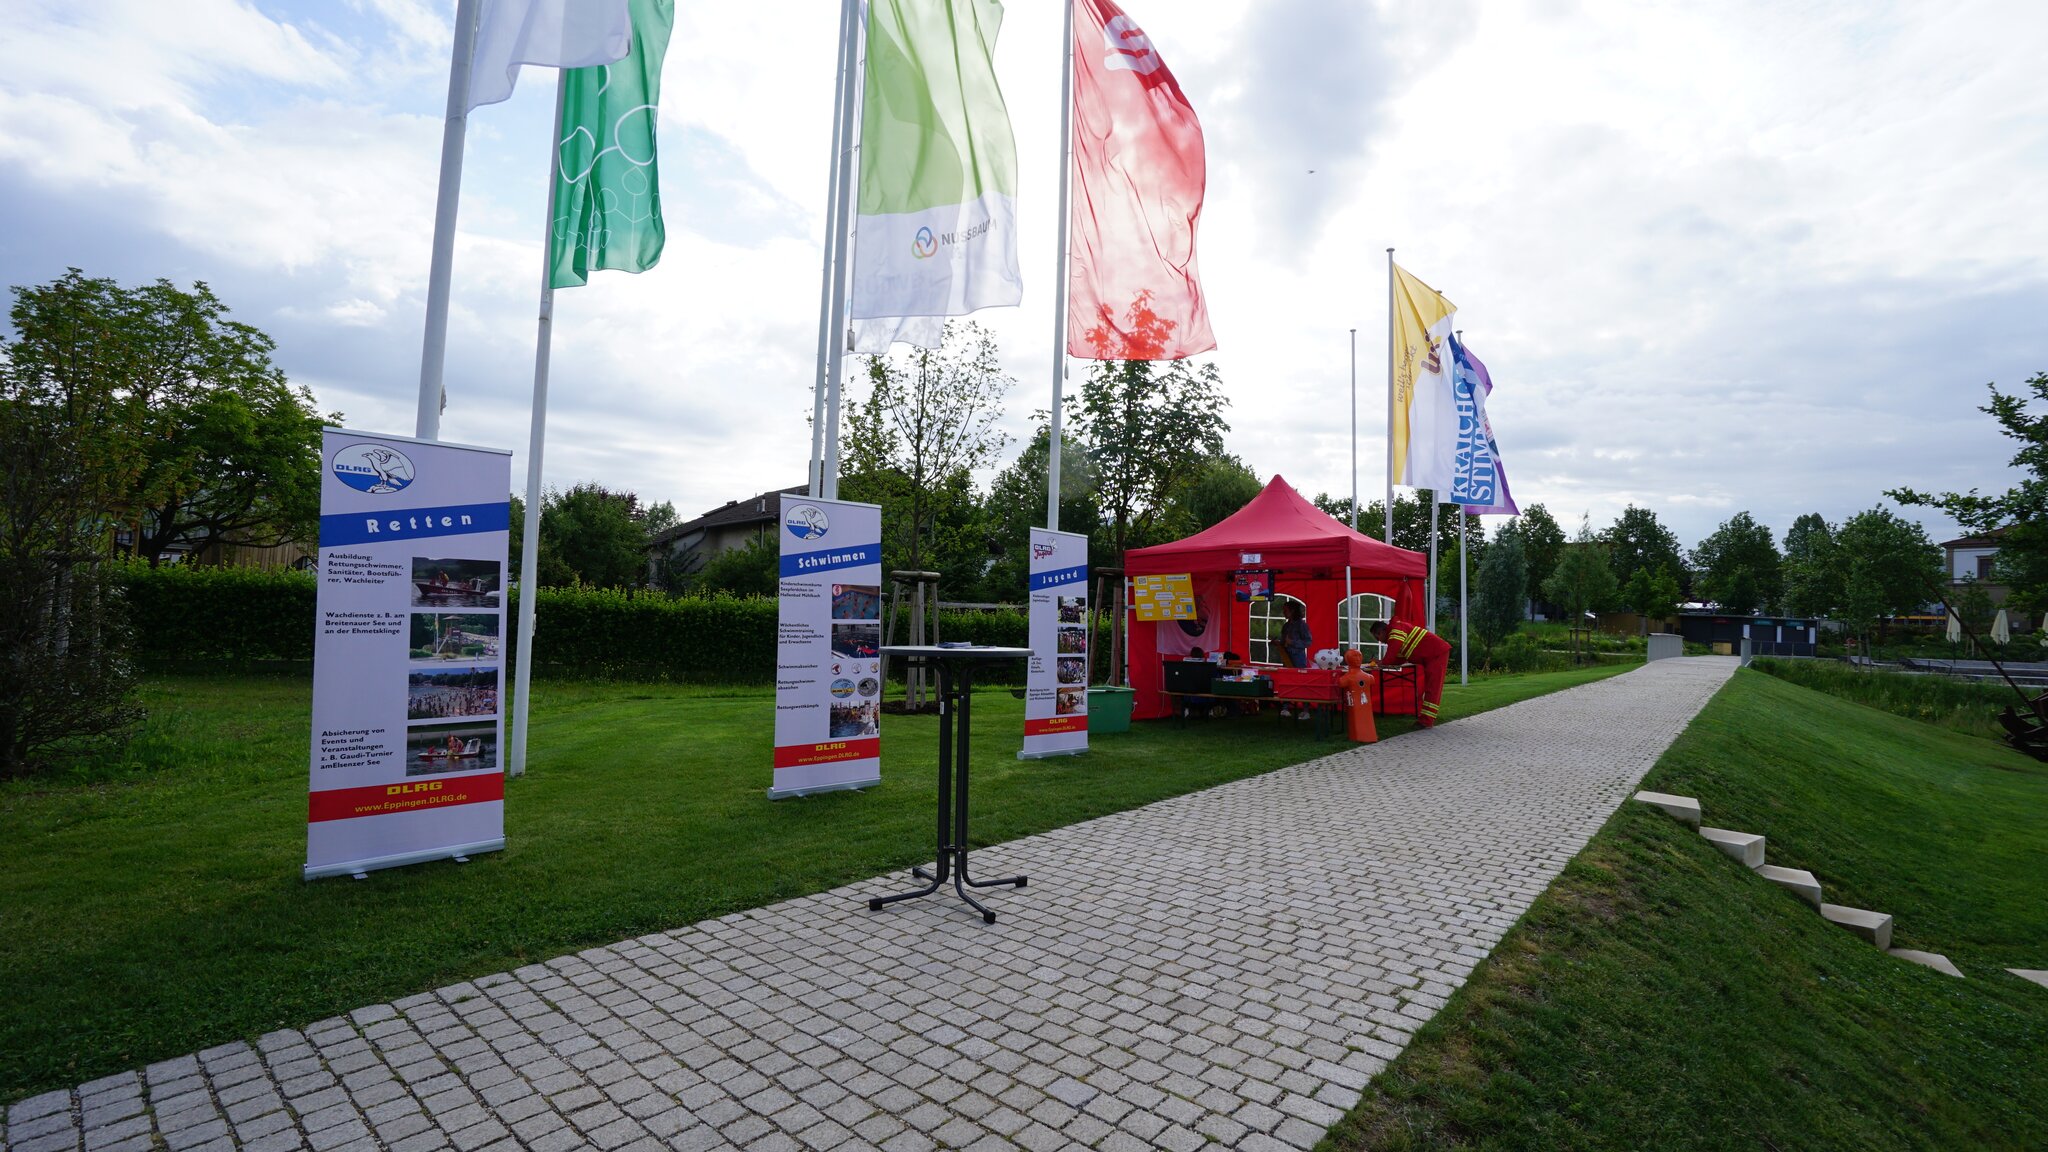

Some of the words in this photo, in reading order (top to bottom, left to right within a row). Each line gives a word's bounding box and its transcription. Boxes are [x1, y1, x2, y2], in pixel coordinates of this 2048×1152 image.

[336, 464, 372, 473] DLRG
[366, 514, 472, 534] Retten
[328, 552, 373, 562] Ausbildung:
[798, 551, 866, 569] Schwimmen
[328, 560, 404, 570] Rettungsschwimmer,
[1042, 570, 1078, 584] Jugend
[322, 729, 370, 737] Absicherung
[321, 744, 384, 753] Veranstaltungen
[815, 742, 847, 751] DLRG
[340, 751, 394, 760] Gaudi-Turnier
[387, 781, 443, 796] DLRG
[354, 793, 468, 813] www.Eppingen.DLRG.de
